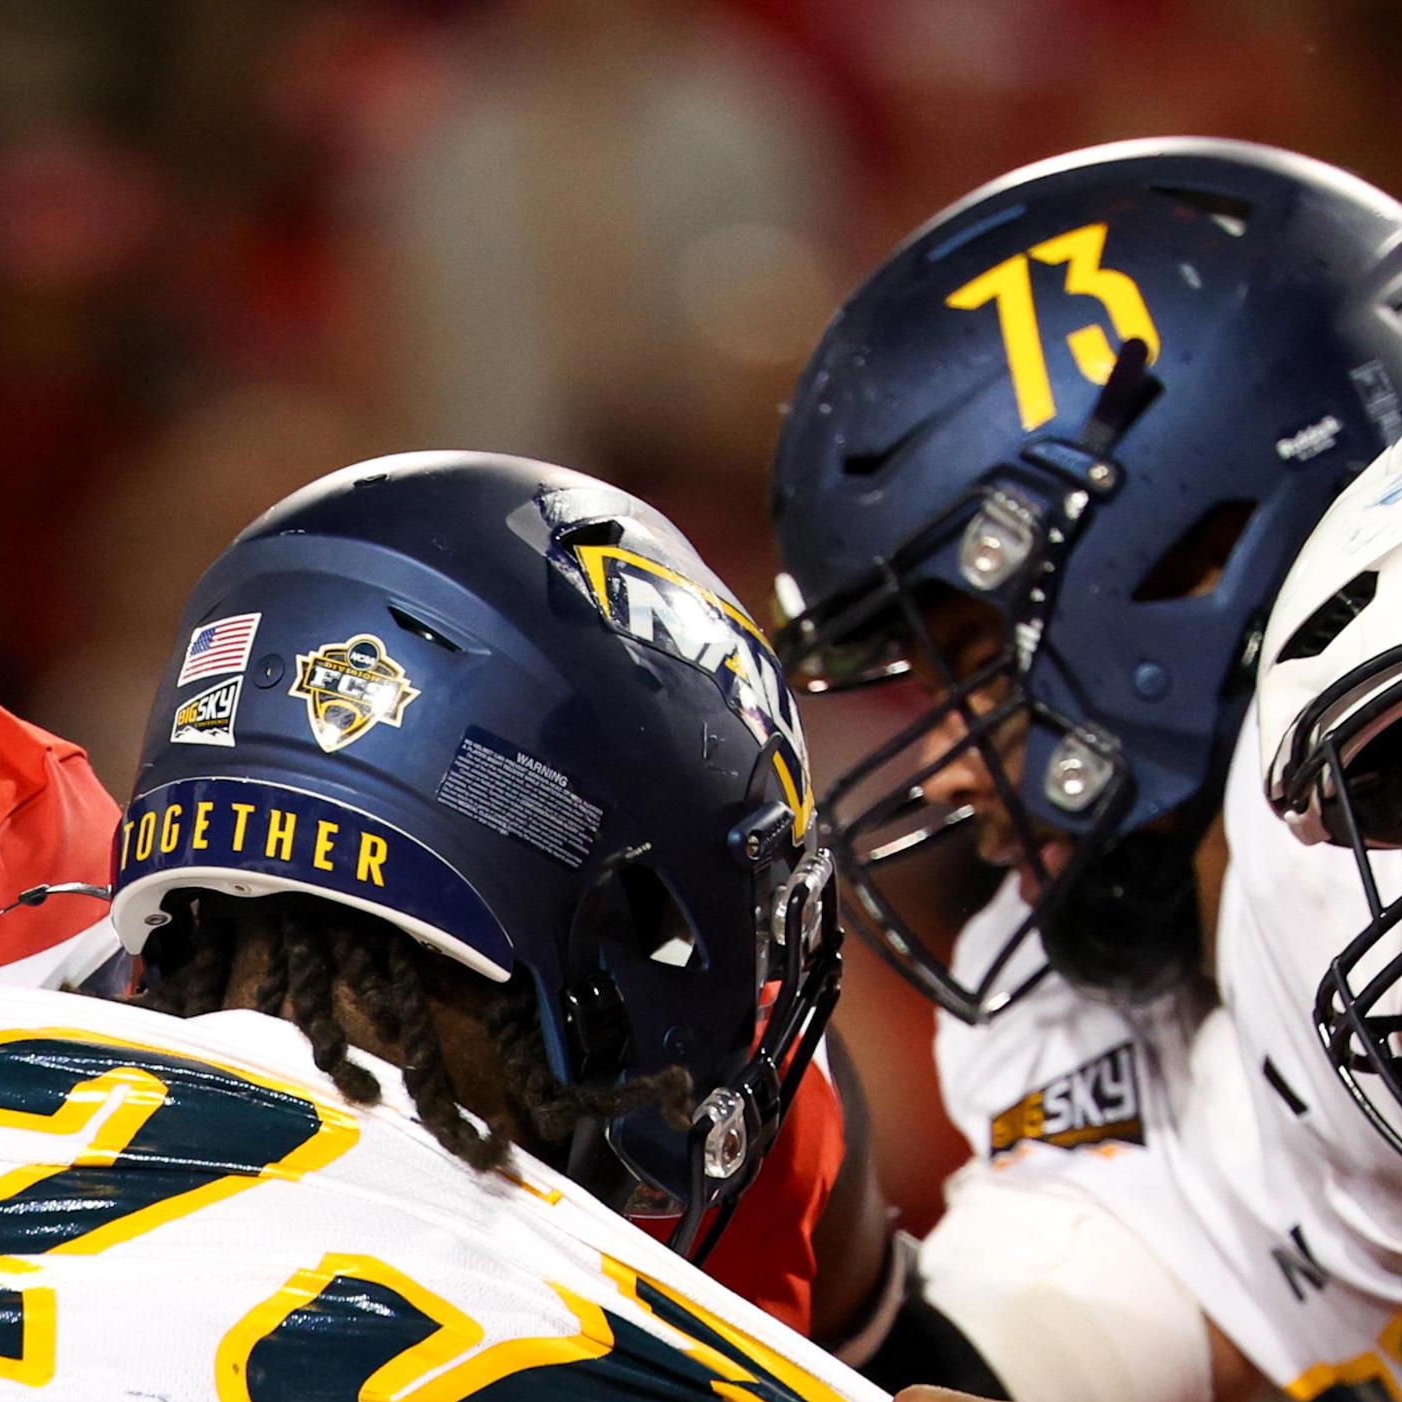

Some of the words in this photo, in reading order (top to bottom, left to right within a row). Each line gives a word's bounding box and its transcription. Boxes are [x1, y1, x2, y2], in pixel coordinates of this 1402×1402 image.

[946, 221, 1161, 431] 73
[516, 752, 568, 788] WARNING
[121, 801, 389, 888] TOGETHER
